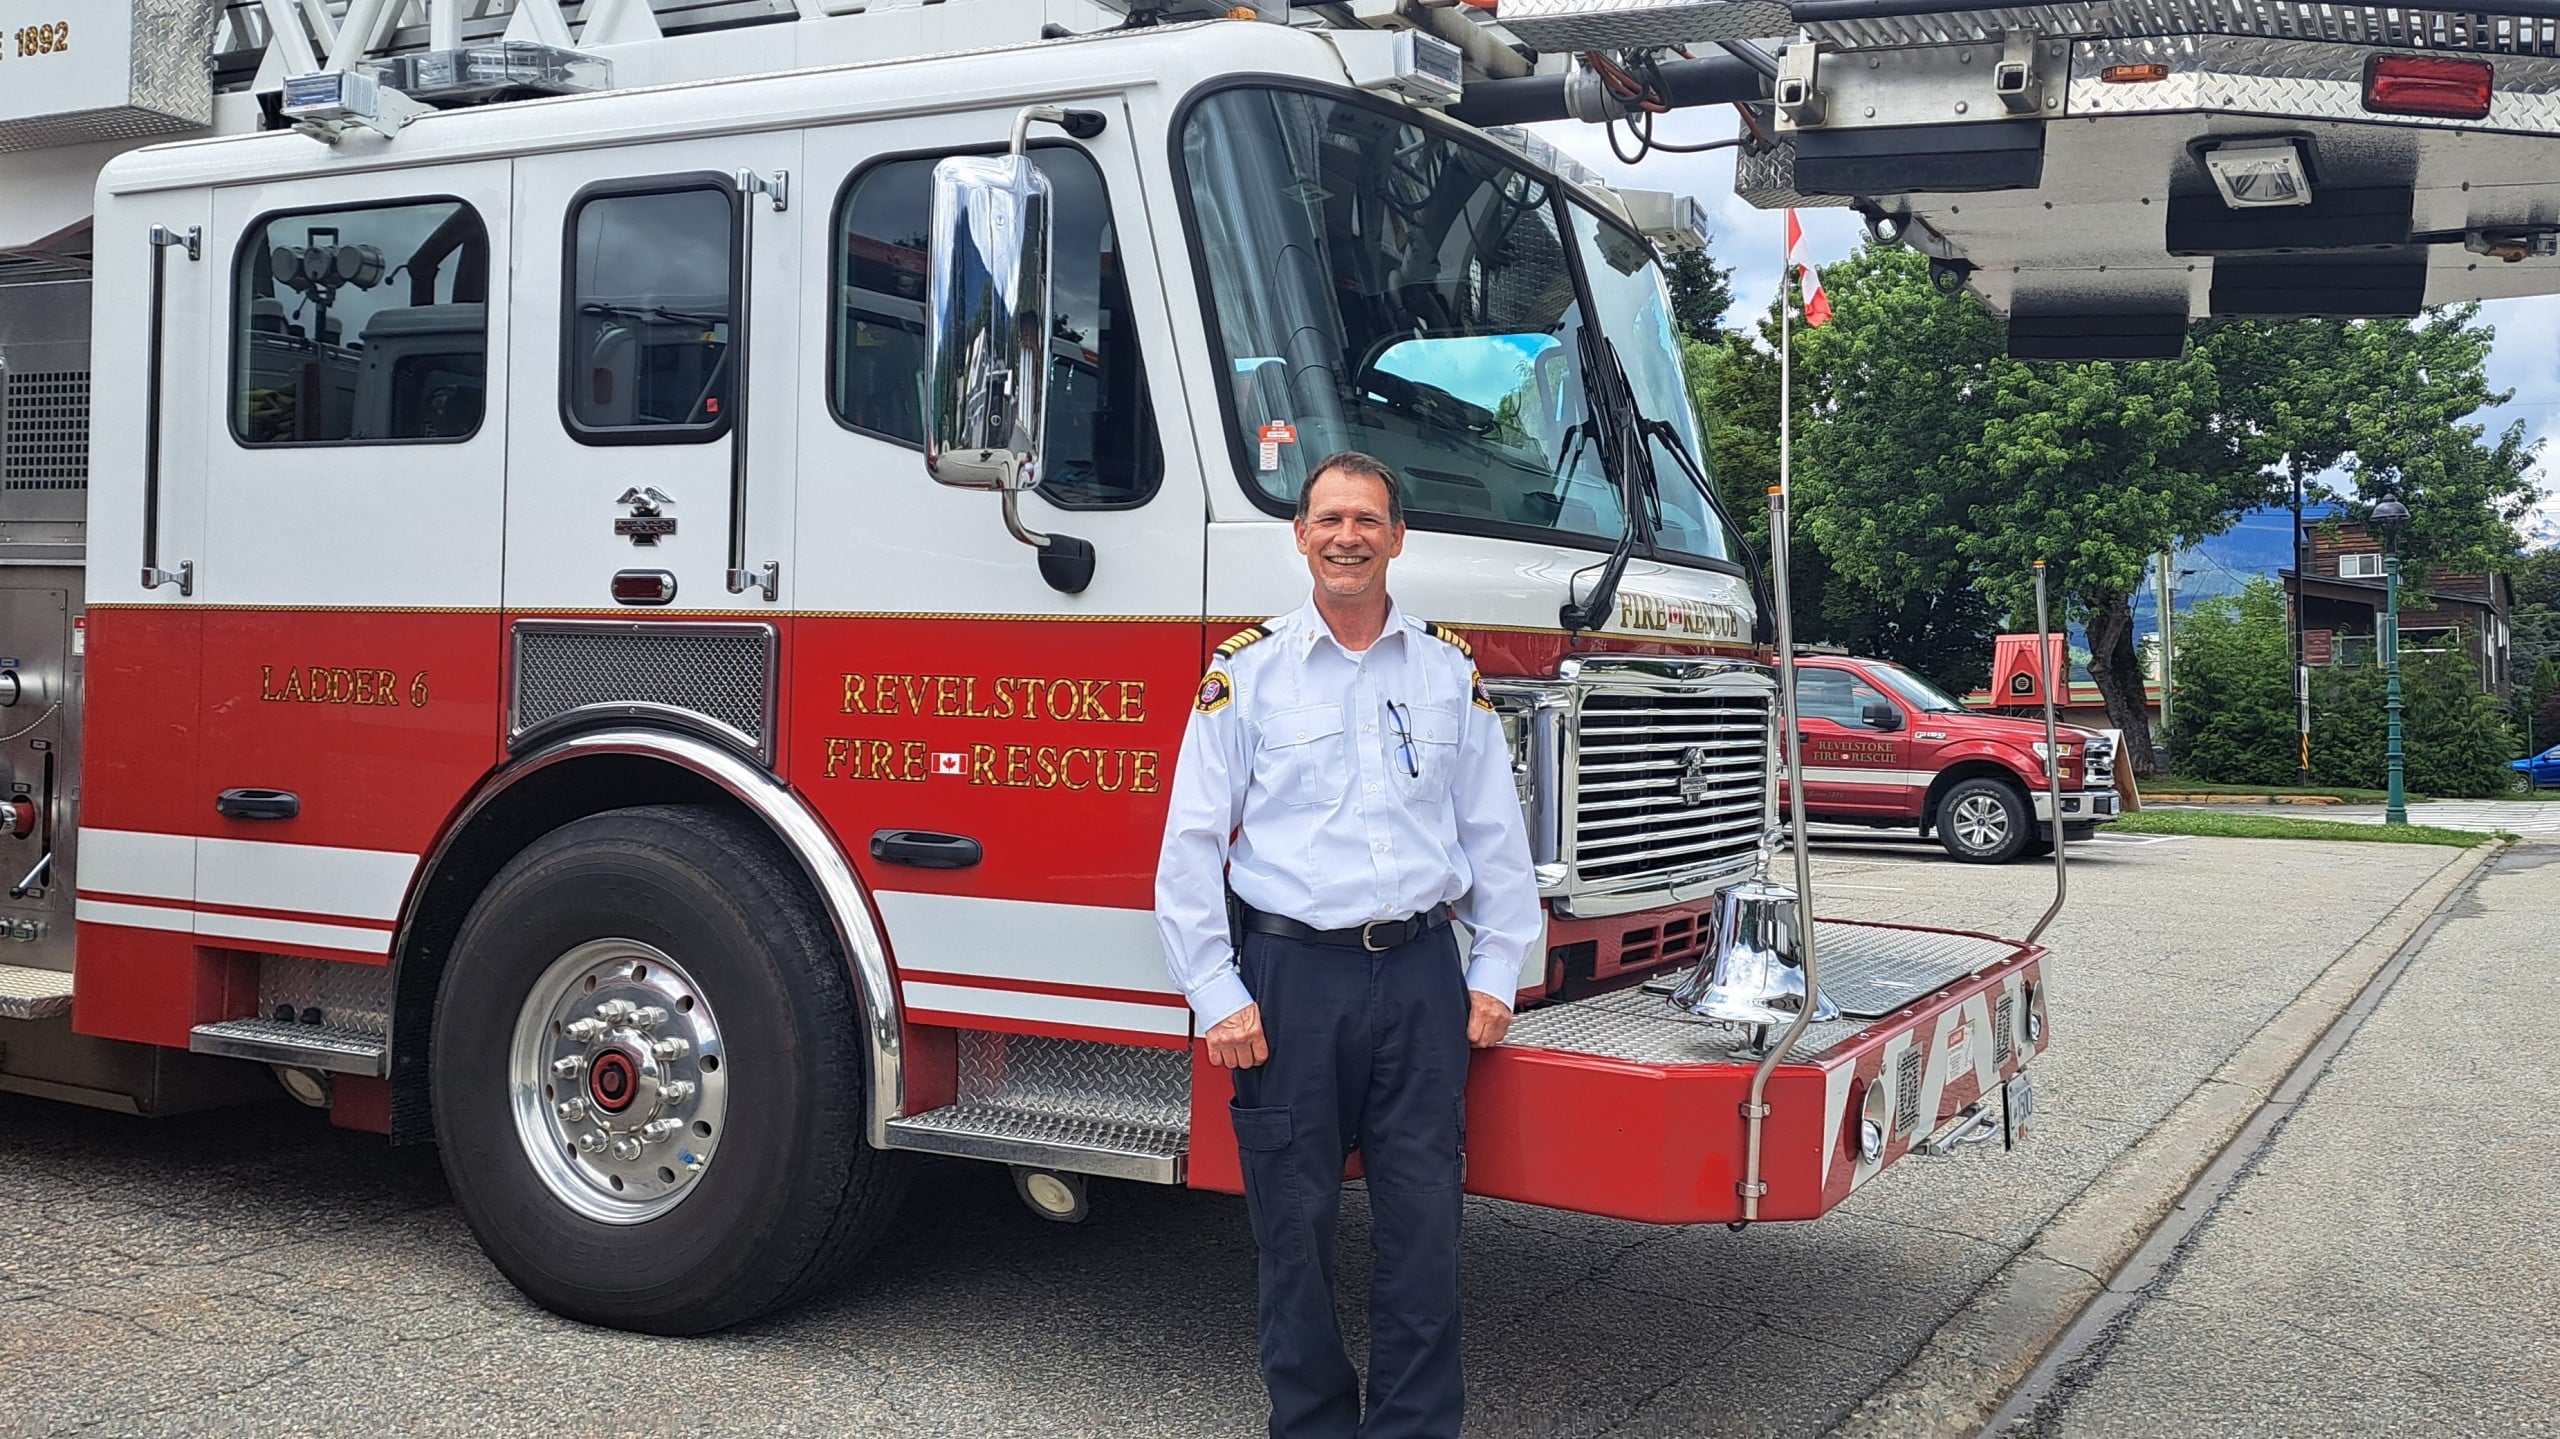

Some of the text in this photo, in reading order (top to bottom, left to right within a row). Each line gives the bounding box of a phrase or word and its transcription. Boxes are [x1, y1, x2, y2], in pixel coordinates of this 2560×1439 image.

[14, 21, 69, 58] 1892
[1617, 591, 1739, 638] FIRE RESCUE
[261, 665, 430, 709] LADDER 6
[840, 673, 1146, 724] REVELSTOKE
[823, 737, 1161, 794] FIRE RESCUE
[1814, 751, 1897, 764] FIRE RESCUE
[1818, 741, 1893, 753] REVELSTOKE
